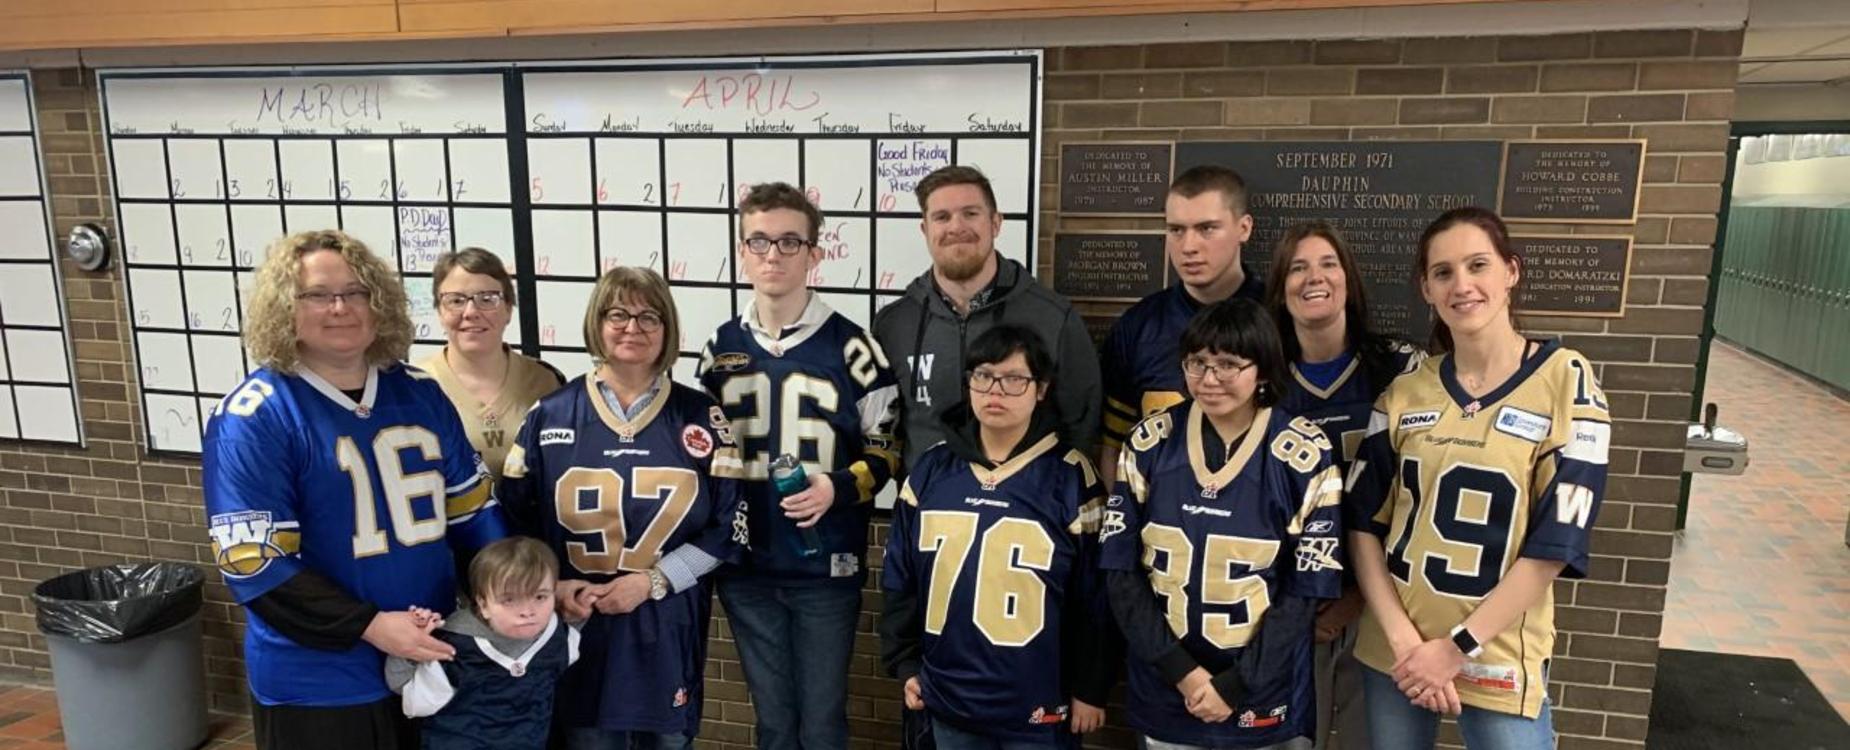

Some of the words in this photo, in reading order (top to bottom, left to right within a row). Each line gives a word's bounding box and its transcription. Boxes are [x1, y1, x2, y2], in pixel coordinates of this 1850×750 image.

[257, 82, 383, 128] MARCH
[683, 73, 820, 117] APRIL
[533, 113, 566, 132] Sunday
[600, 113, 640, 132] Monday
[668, 119, 714, 133] Tuesday
[745, 117, 795, 133] Wednesday
[812, 112, 860, 133] Thursday
[889, 112, 926, 133] Friday
[968, 112, 1022, 132] Saturday
[879, 142, 907, 161] Good
[913, 141, 948, 164] Friday
[1085, 151, 1132, 160] DEDICATED
[1135, 151, 1148, 160] TO
[1276, 152, 1357, 169] SEPTEMBER
[1366, 152, 1393, 169] 1971
[1541, 151, 1591, 159] DEDICATED
[1594, 151, 1607, 159] TO
[1081, 161, 1096, 170] THE
[1102, 161, 1136, 170] MEMORY
[1140, 161, 1151, 170] OF
[1068, 172, 1111, 183] AUSTIN
[1117, 172, 1163, 183] MILLER
[1302, 175, 1370, 192] DAUPHIN
[1521, 171, 1576, 182] HOWARD
[1581, 172, 1621, 182] COBBE
[174, 178, 186, 198] 2
[230, 179, 241, 197] 3
[266, 178, 277, 199] 2
[340, 180, 351, 199] 5
[380, 179, 390, 199] 2
[455, 179, 467, 200] 7
[532, 177, 544, 202] 5
[598, 178, 609, 202] 6
[643, 182, 655, 204] 2
[670, 182, 680, 206] 7
[1558, 187, 1623, 195] CONSTRUCTION
[879, 192, 897, 212] 10
[1251, 192, 1350, 209] COMPREHENSIVE
[1353, 192, 1422, 210] SECONDARY
[1427, 193, 1477, 210] SCHOOL
[1344, 217, 1369, 229] JOINT
[1372, 217, 1409, 229] EFFORTS
[1412, 218, 1423, 229] OF
[216, 238, 228, 261] 2
[1525, 245, 1581, 254] DEDICATED
[1584, 246, 1598, 254] TO
[538, 255, 549, 275] 12
[1068, 261, 1110, 271] MORGAN
[1112, 261, 1147, 271] BROWN
[1523, 257, 1540, 266] THE
[1544, 257, 1585, 266] MEMORY
[1588, 258, 1600, 267] OF
[879, 270, 895, 289] 17
[1549, 270, 1620, 281] DOMARATZKI
[190, 312, 201, 328] 16
[222, 307, 234, 330] 2
[907, 352, 935, 381] W
[721, 372, 839, 481] 26
[1401, 414, 1437, 426] RONA
[482, 430, 506, 449] W
[335, 424, 447, 560] 16
[1555, 482, 1594, 529] W
[555, 466, 699, 575] 97
[1387, 457, 1521, 601] 19
[208, 520, 271, 551] W
[918, 509, 1056, 648] 76
[1140, 521, 1282, 650] 85
